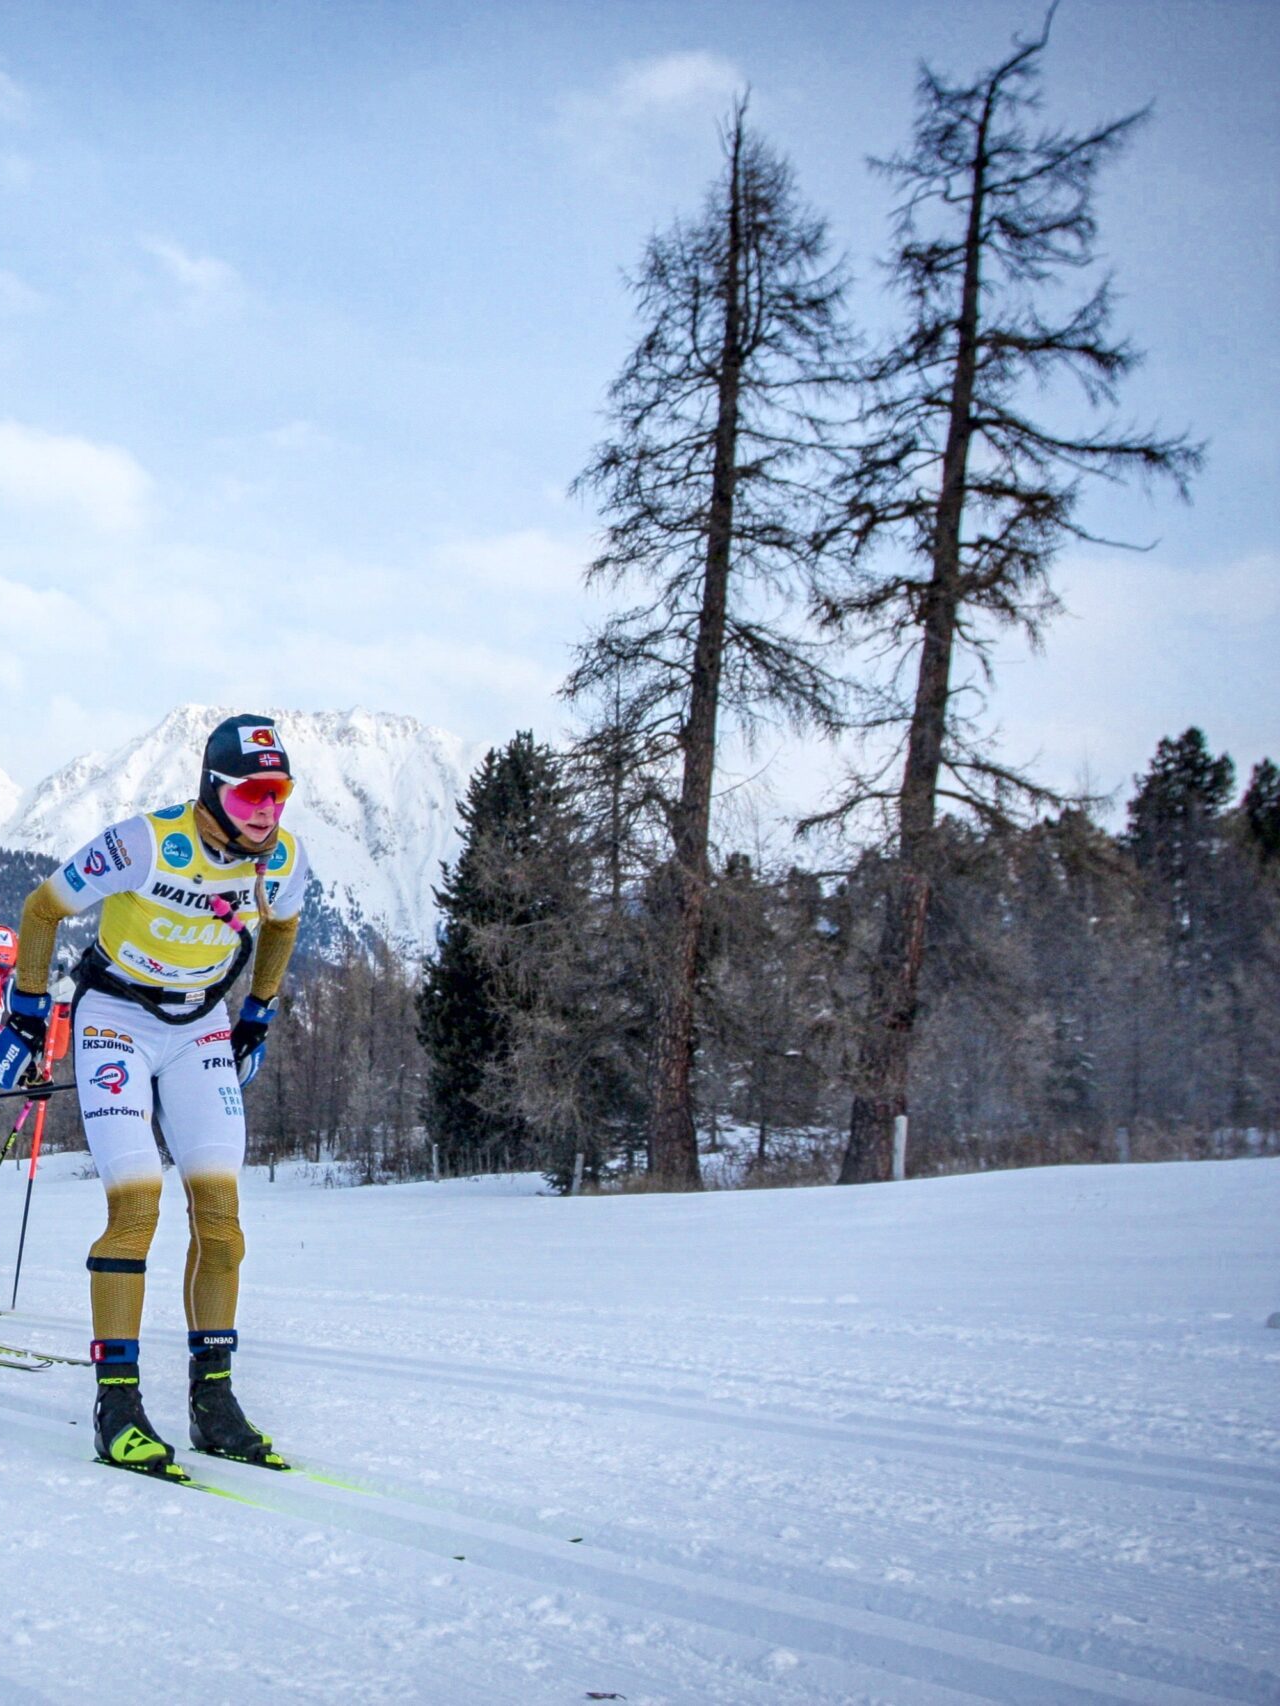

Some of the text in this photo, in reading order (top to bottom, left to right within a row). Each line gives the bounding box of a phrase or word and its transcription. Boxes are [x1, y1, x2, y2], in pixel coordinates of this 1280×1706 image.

[149, 916, 241, 946] CHAM
[82, 1039, 135, 1054] EKSJÖHUS
[89, 1072, 119, 1085] Thermia
[203, 1336, 235, 1345] OVENTO
